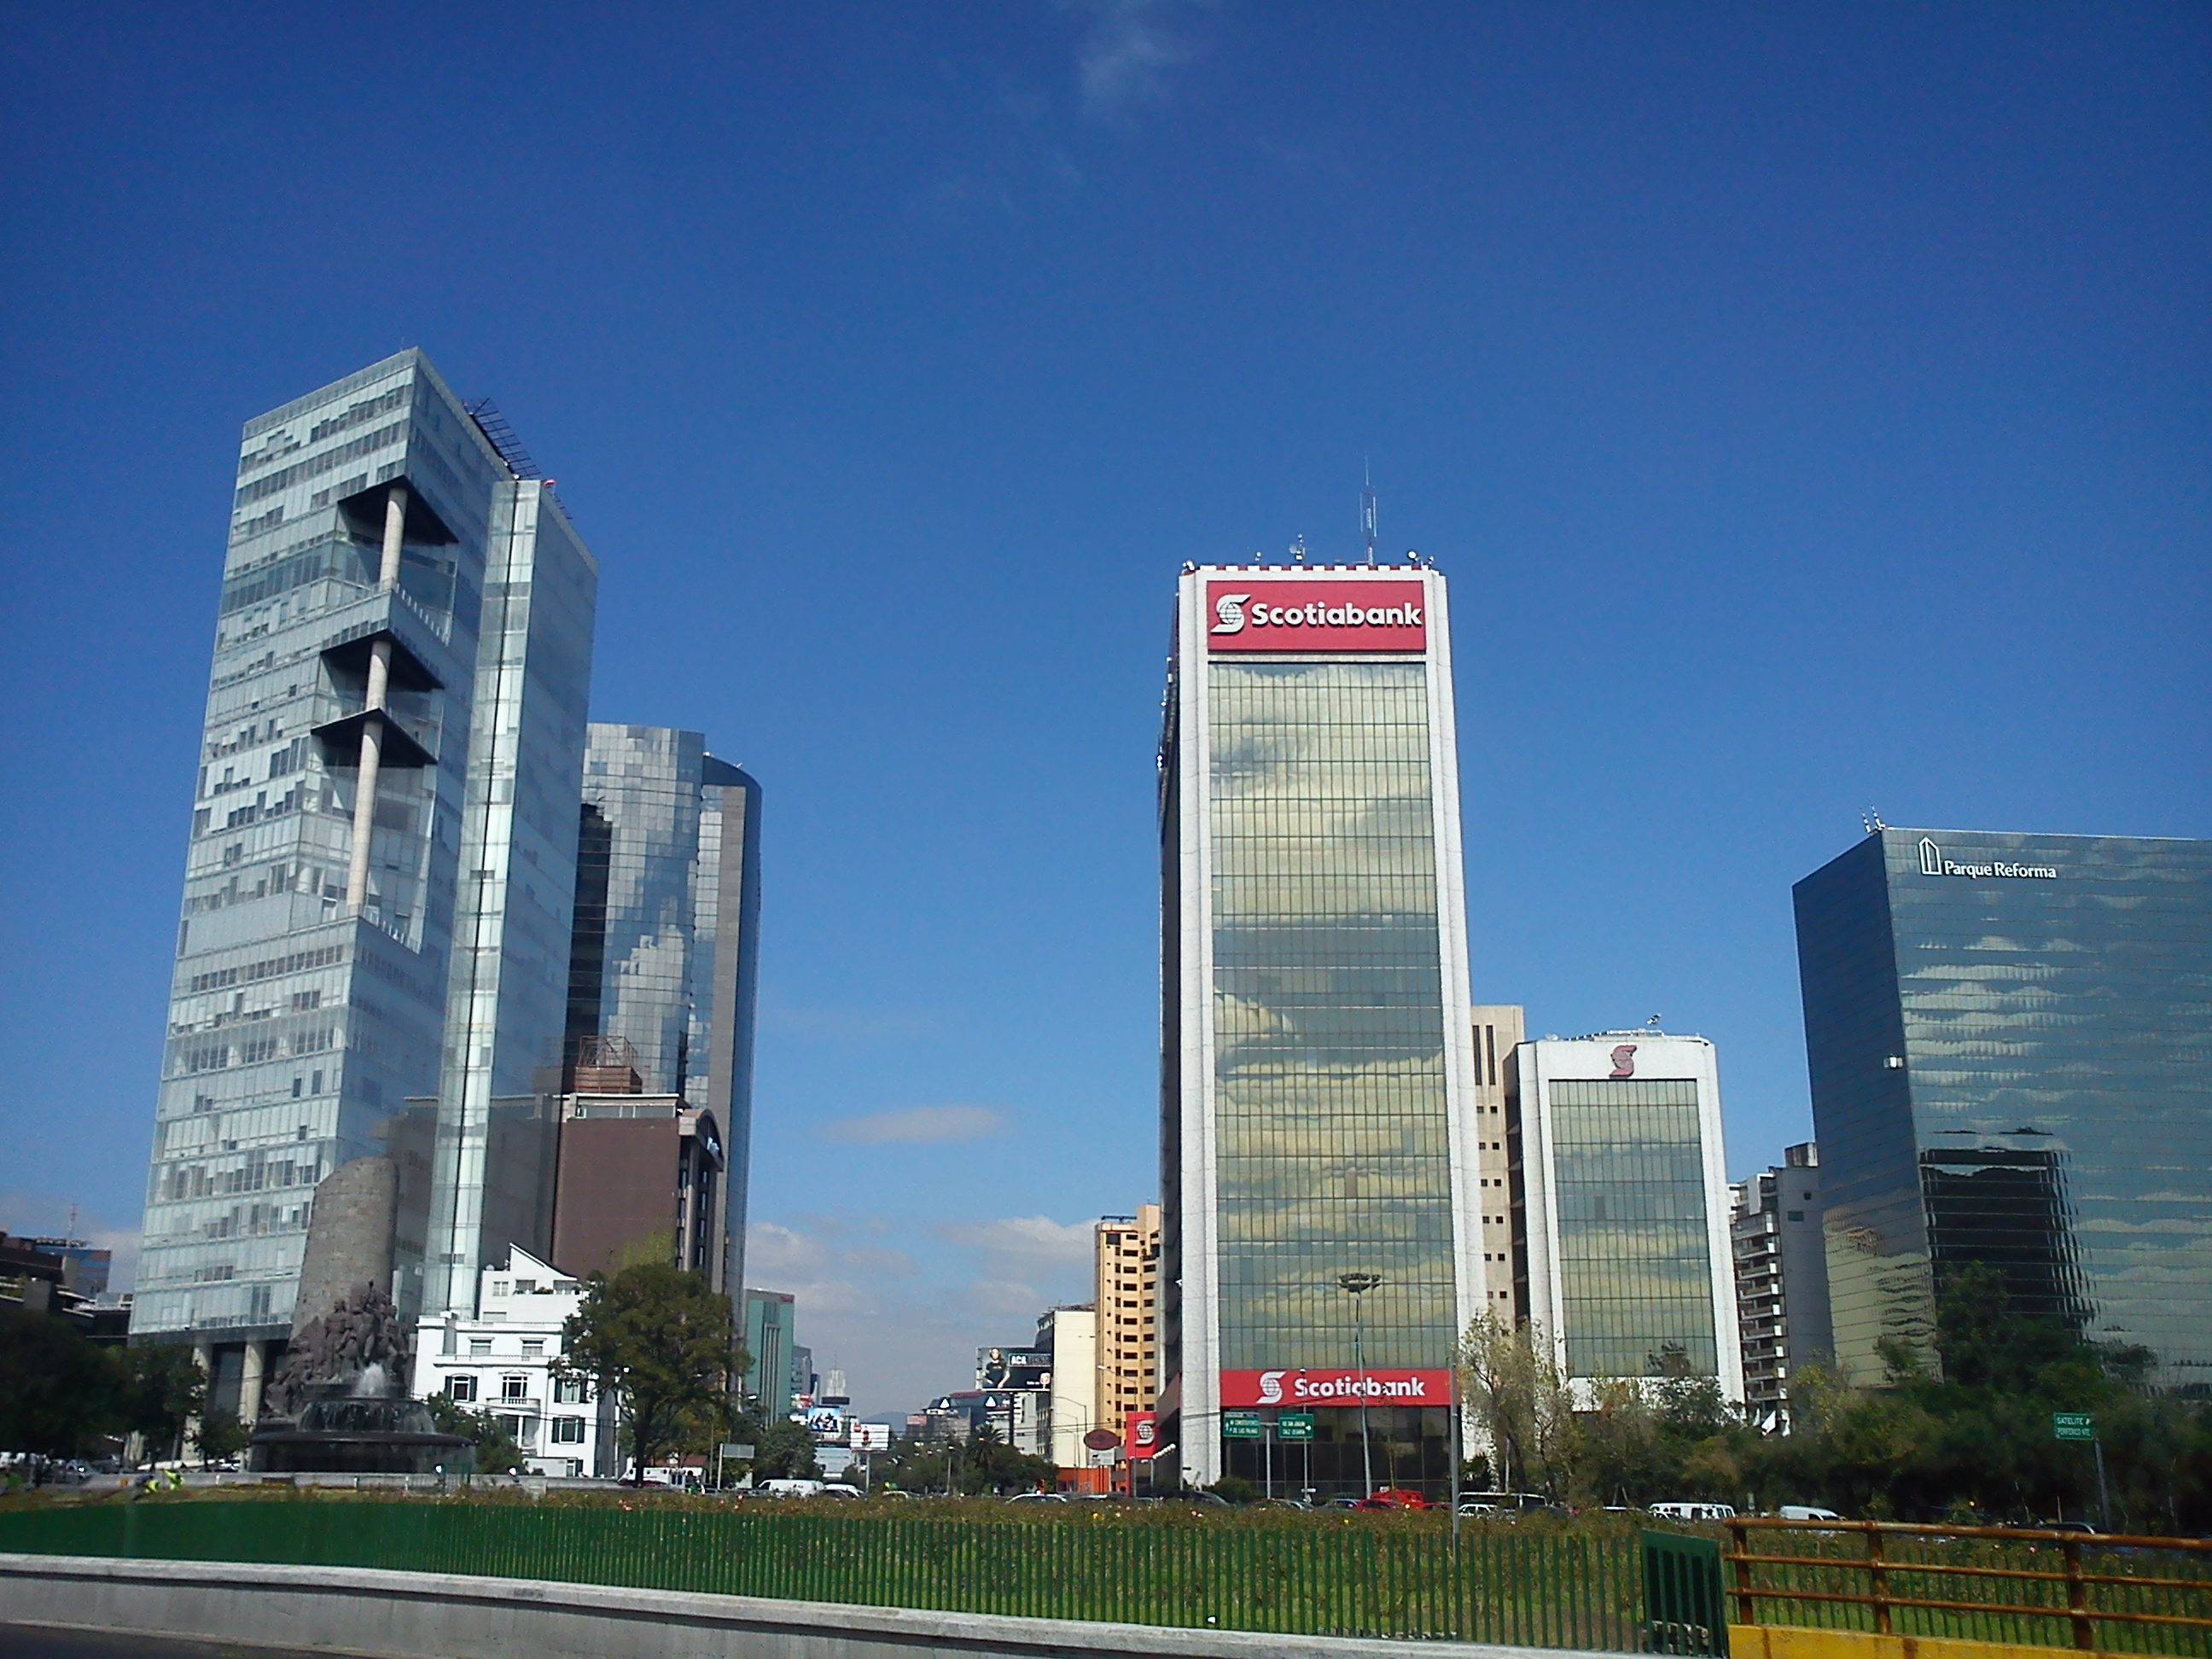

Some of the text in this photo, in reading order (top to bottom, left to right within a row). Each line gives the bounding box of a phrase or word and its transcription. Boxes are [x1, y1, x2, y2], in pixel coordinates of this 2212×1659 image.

[1251, 601, 1423, 626] Scotiabank
[1944, 859, 2057, 879] Parque Reforma
[1294, 1377, 1425, 1397] Scotiabank
[2057, 1417, 2084, 1425] SATELITE
